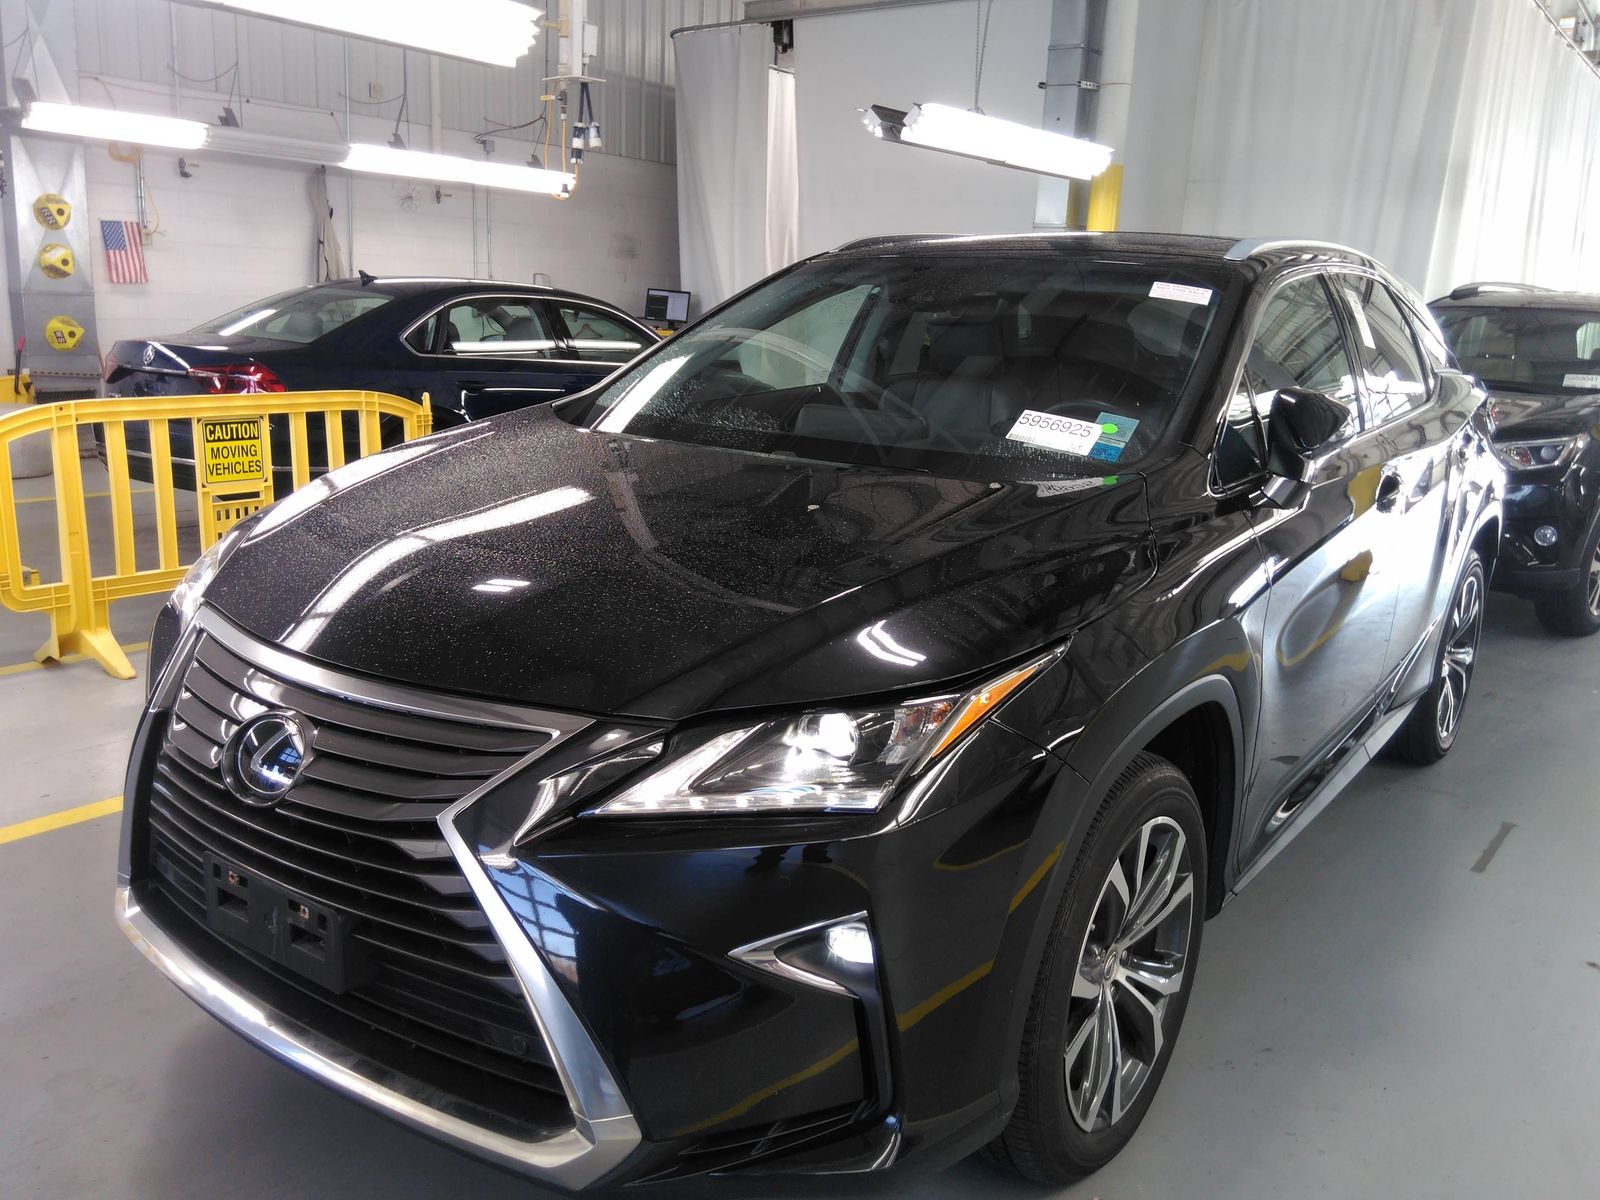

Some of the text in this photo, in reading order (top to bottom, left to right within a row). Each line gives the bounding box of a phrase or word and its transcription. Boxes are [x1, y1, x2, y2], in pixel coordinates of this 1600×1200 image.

[206, 423, 258, 440] CAUTION
[1018, 413, 1094, 437] 5956925
[211, 444, 257, 460] MOVING
[207, 460, 262, 476] VEHICLES
